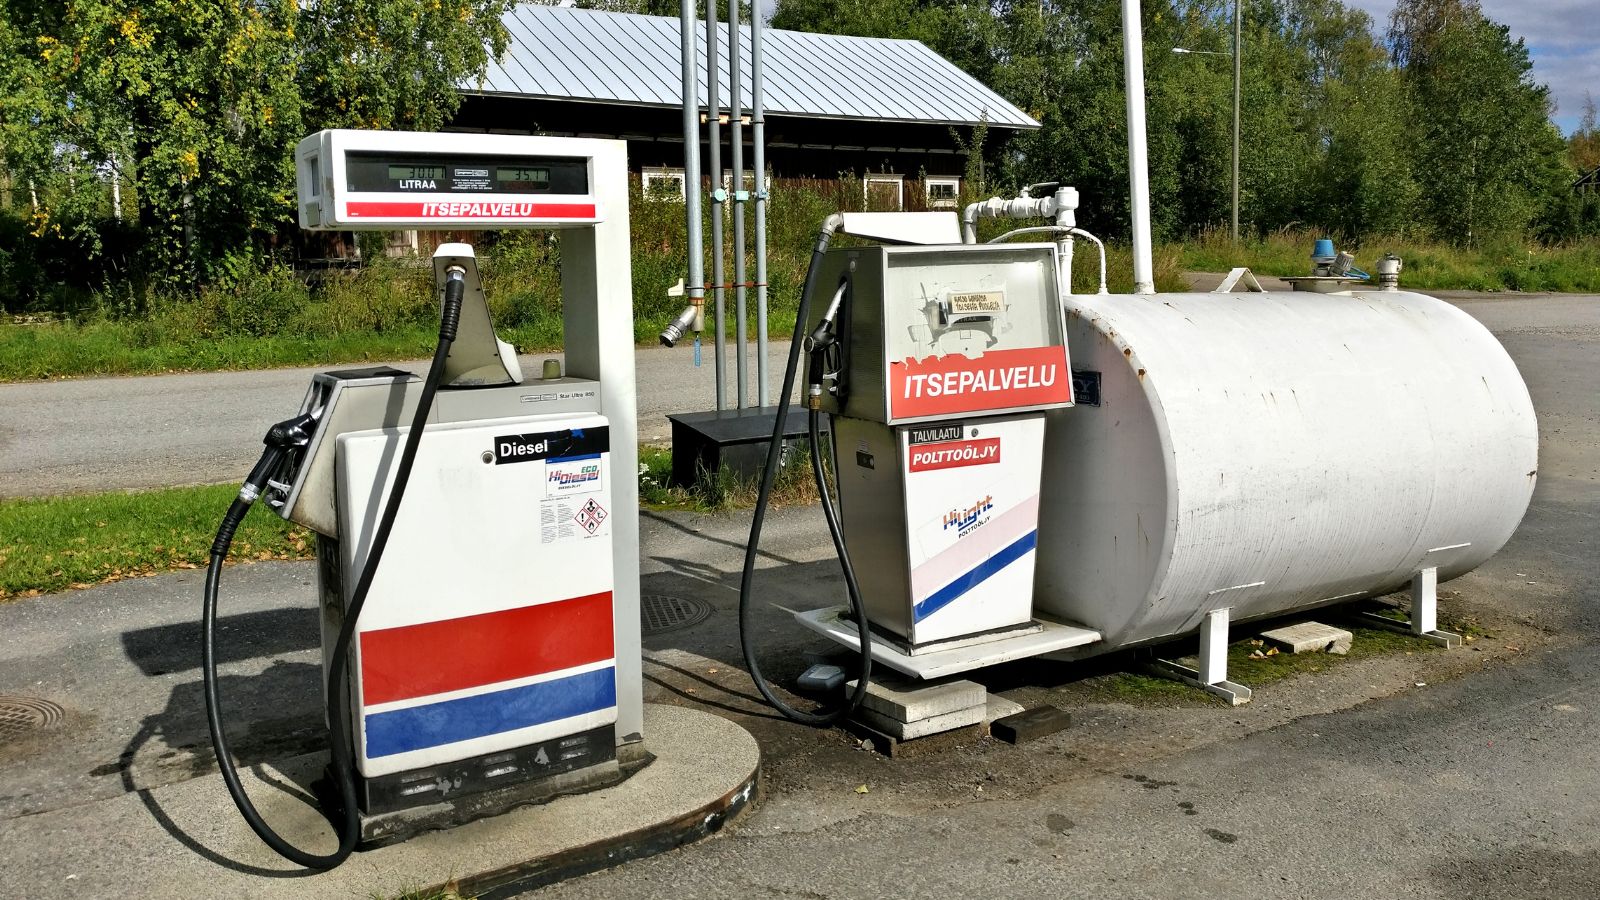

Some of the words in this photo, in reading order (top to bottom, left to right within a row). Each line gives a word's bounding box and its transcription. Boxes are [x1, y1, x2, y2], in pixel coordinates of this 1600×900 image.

[399, 179, 437, 190] LITRAA
[421, 202, 533, 217] ITSEPALVELU
[904, 363, 1056, 399] ITSEPALVELU
[912, 427, 961, 442] TALVILAATU
[500, 439, 549, 457] Diesel
[912, 444, 998, 465] POLTTOÖLJY
[581, 465, 598, 473] ECO
[958, 515, 991, 539] POLTTOÖLJY
